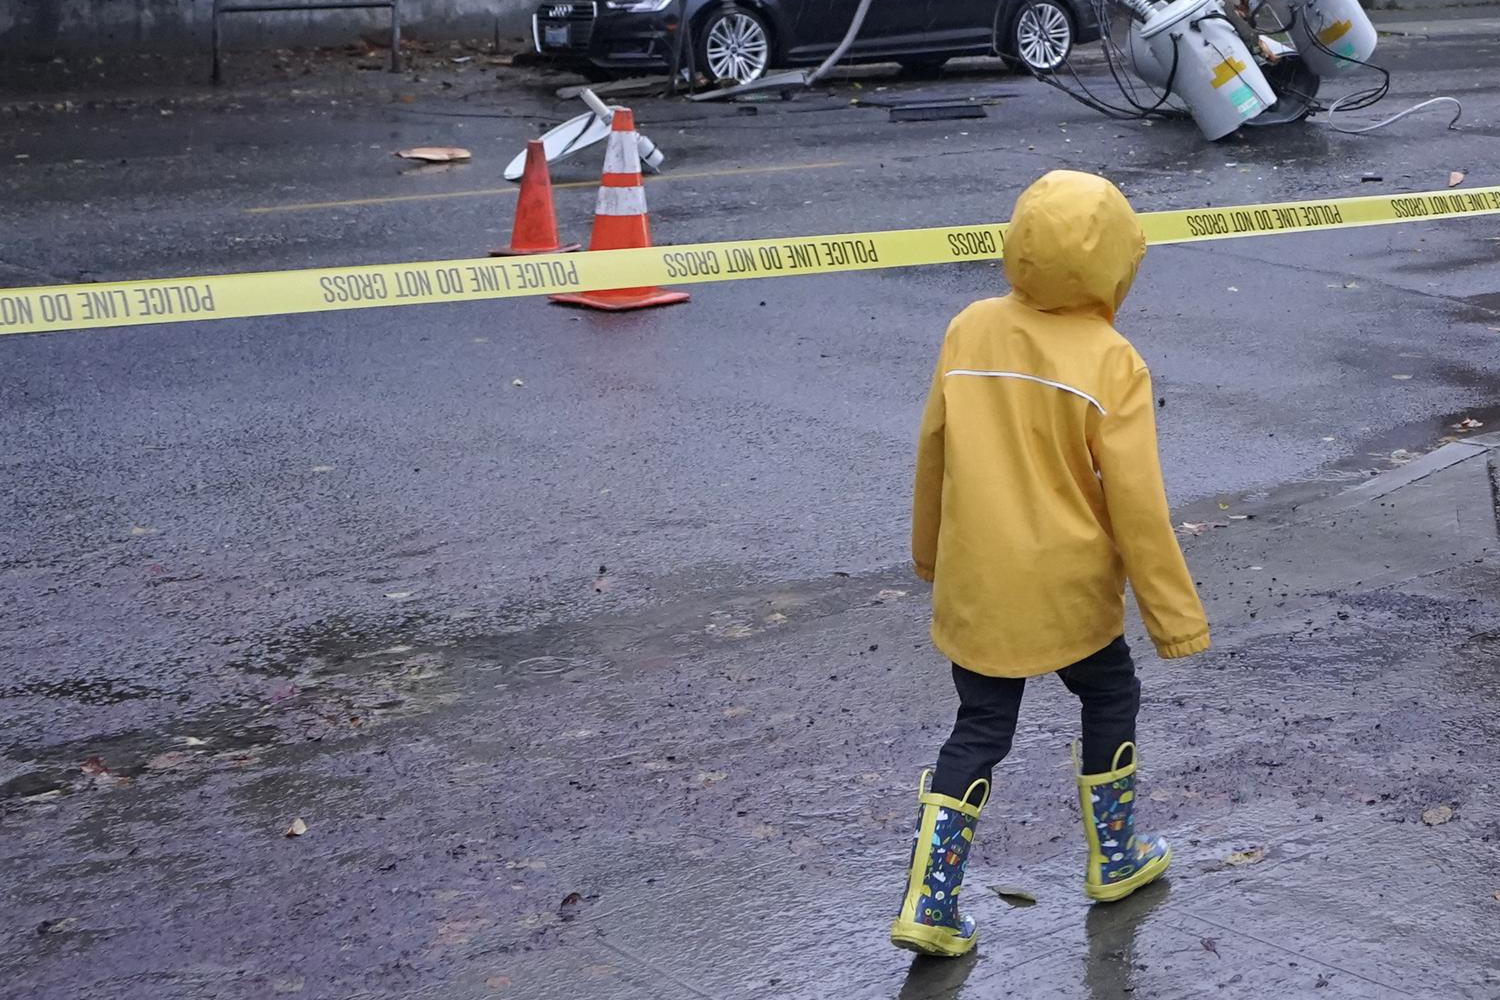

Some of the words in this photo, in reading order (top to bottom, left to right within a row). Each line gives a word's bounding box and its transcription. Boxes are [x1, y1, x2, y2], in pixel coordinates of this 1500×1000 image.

[1390, 198, 1428, 218] CROSS
[1430, 196, 1450, 214] NOT
[1451, 194, 1468, 212] DO
[1468, 192, 1491, 210] LINE
[1186, 213, 1228, 236] CROSS
[1229, 211, 1255, 232] NOT
[1254, 209, 1273, 230] DO
[1272, 208, 1301, 228] LINE
[1300, 204, 1343, 226] POLICE
[783, 243, 822, 269] LINE
[820, 239, 879, 266] POLICE
[947, 231, 996, 256] CROSS
[663, 250, 720, 278] CROSS
[726, 247, 757, 273] NOT
[759, 245, 783, 271] DO
[319, 272, 388, 303] CROSS
[394, 270, 433, 298] NOT
[436, 268, 464, 295] DO
[465, 265, 511, 293] LINE
[511, 260, 579, 289] POLICE
[0, 296, 34, 326] NO
[40, 293, 73, 322] DO
[77, 290, 130, 320] LINE
[134, 284, 215, 316] POLICE
